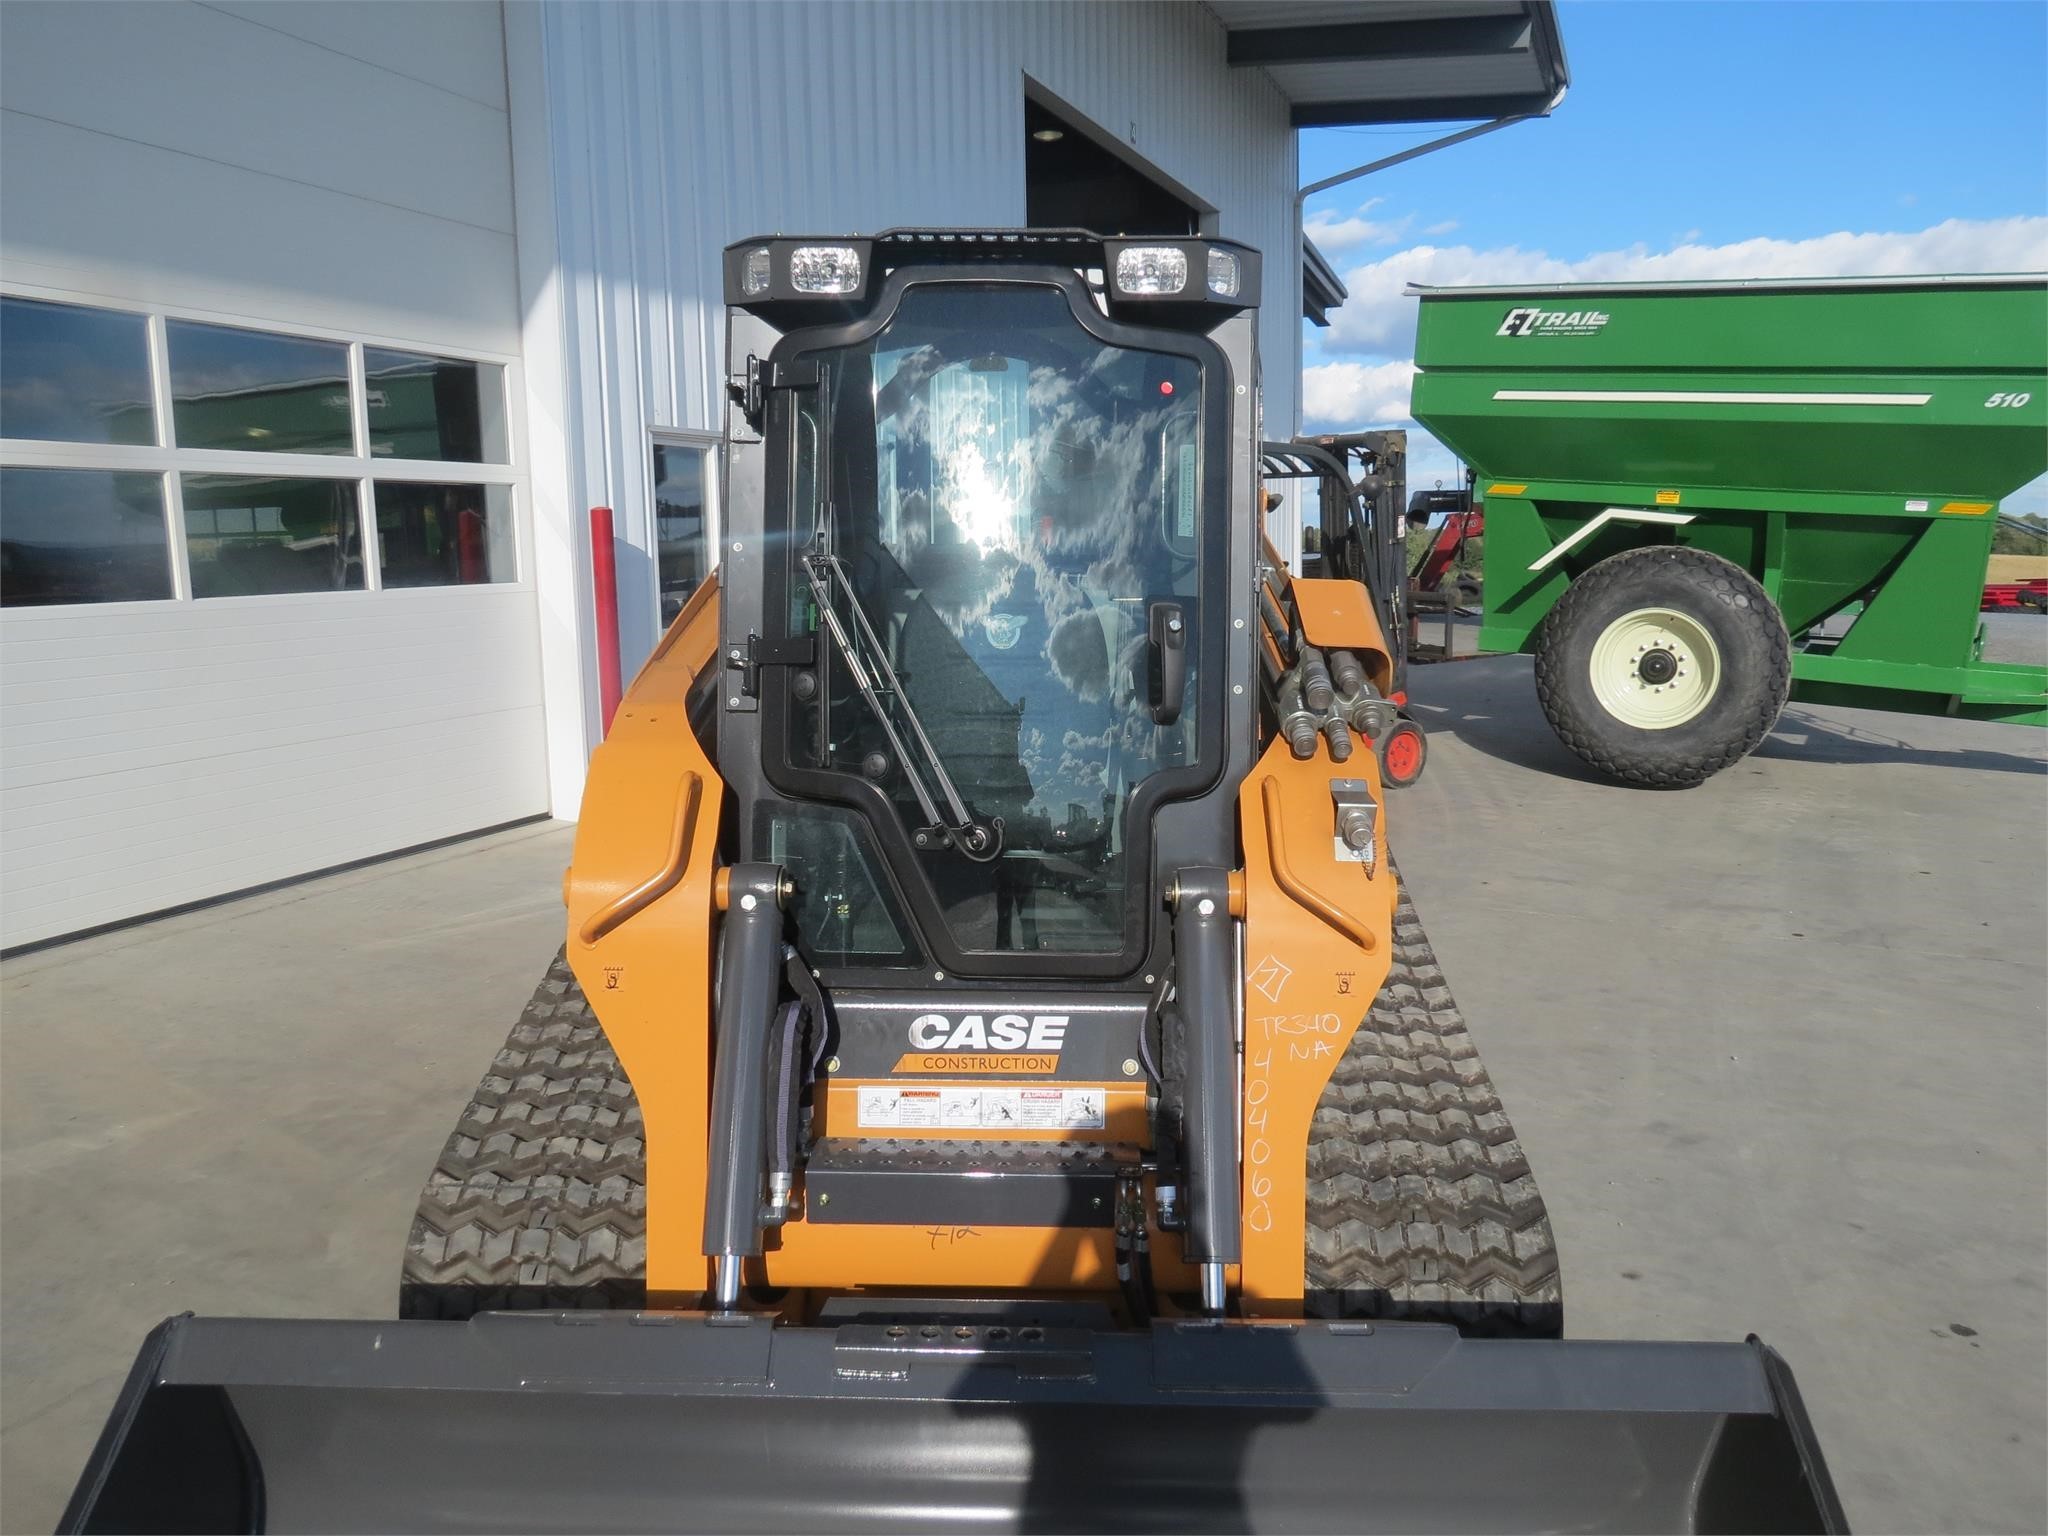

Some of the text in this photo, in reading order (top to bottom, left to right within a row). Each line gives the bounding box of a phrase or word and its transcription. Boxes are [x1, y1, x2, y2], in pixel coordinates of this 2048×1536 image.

[1534, 312, 1609, 326] TRAIL
[1984, 393, 2030, 408] 510
[908, 1014, 1070, 1050] CASE
[923, 1056, 1052, 1070] CONSTRUCTION
